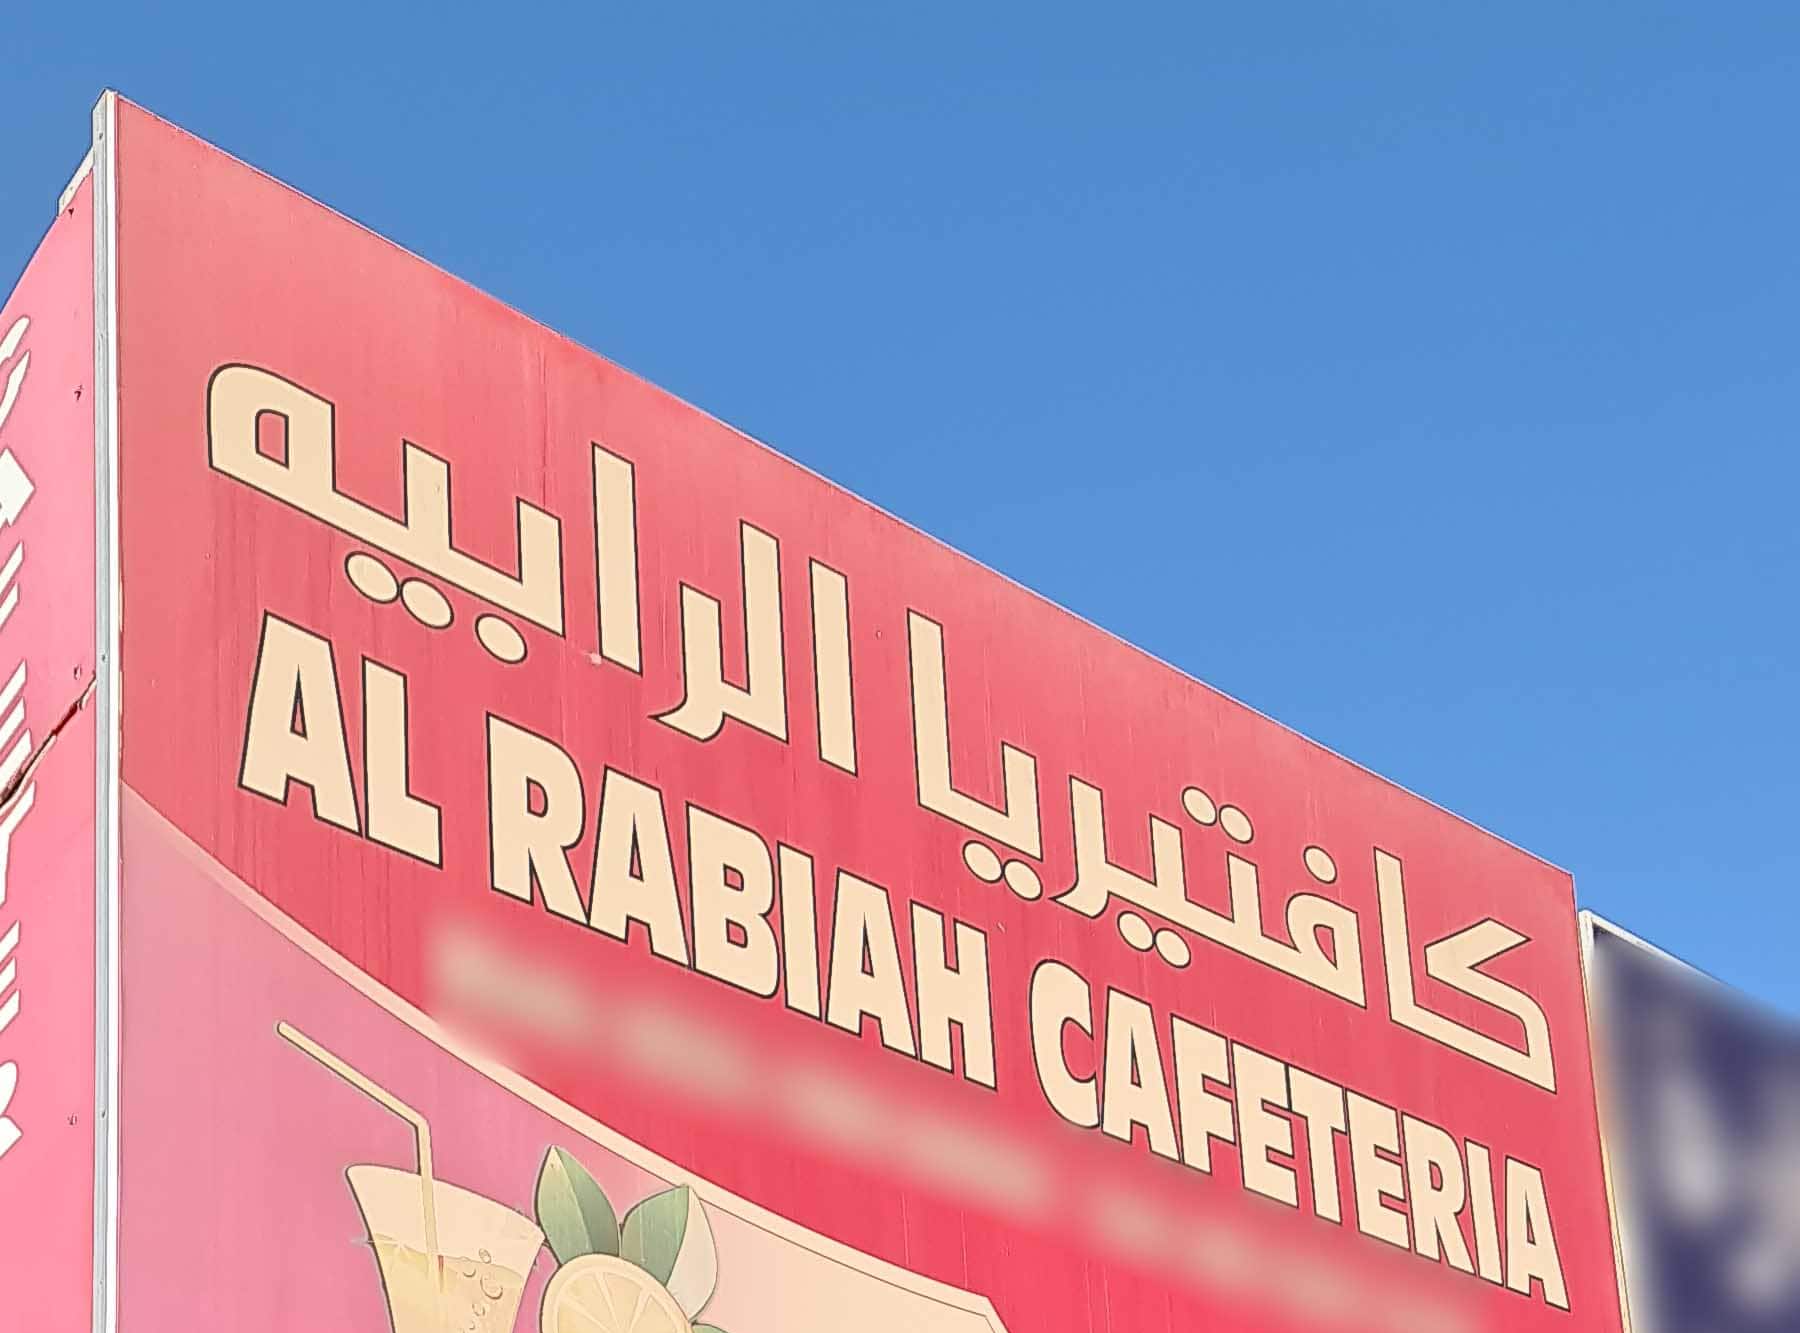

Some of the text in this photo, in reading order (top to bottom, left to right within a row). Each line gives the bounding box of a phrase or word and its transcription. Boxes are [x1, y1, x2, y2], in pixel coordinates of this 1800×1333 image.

[207, 363, 1557, 1094] كافتيريا الرابيه
[238, 610, 443, 869] AL
[487, 712, 997, 1091] RABIAH
[1029, 958, 1570, 1312] CAFETERIA
